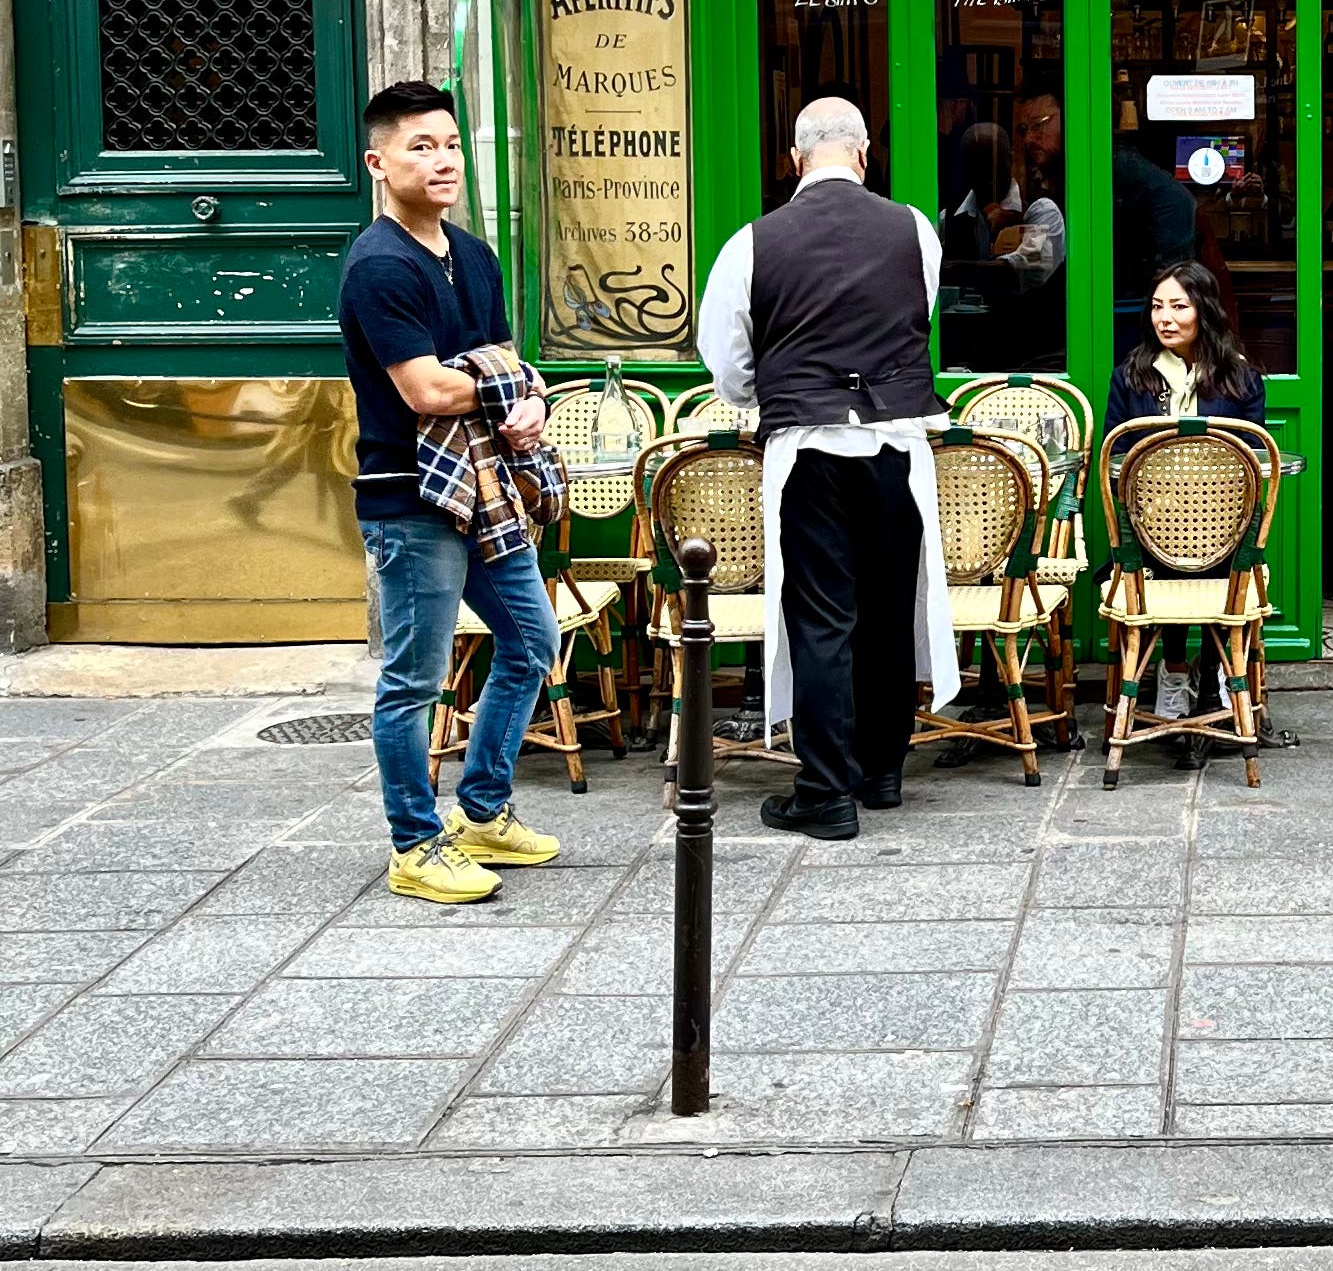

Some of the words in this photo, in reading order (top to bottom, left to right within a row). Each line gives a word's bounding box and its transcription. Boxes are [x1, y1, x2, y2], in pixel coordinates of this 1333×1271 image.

[595, 33, 628, 49] DE
[553, 63, 677, 98] MARQUES
[551, 124, 681, 158] TÉLÉPHONE
[553, 175, 680, 200] Paris-Province
[556, 221, 617, 243] Archives
[624, 221, 682, 243] 38-50
